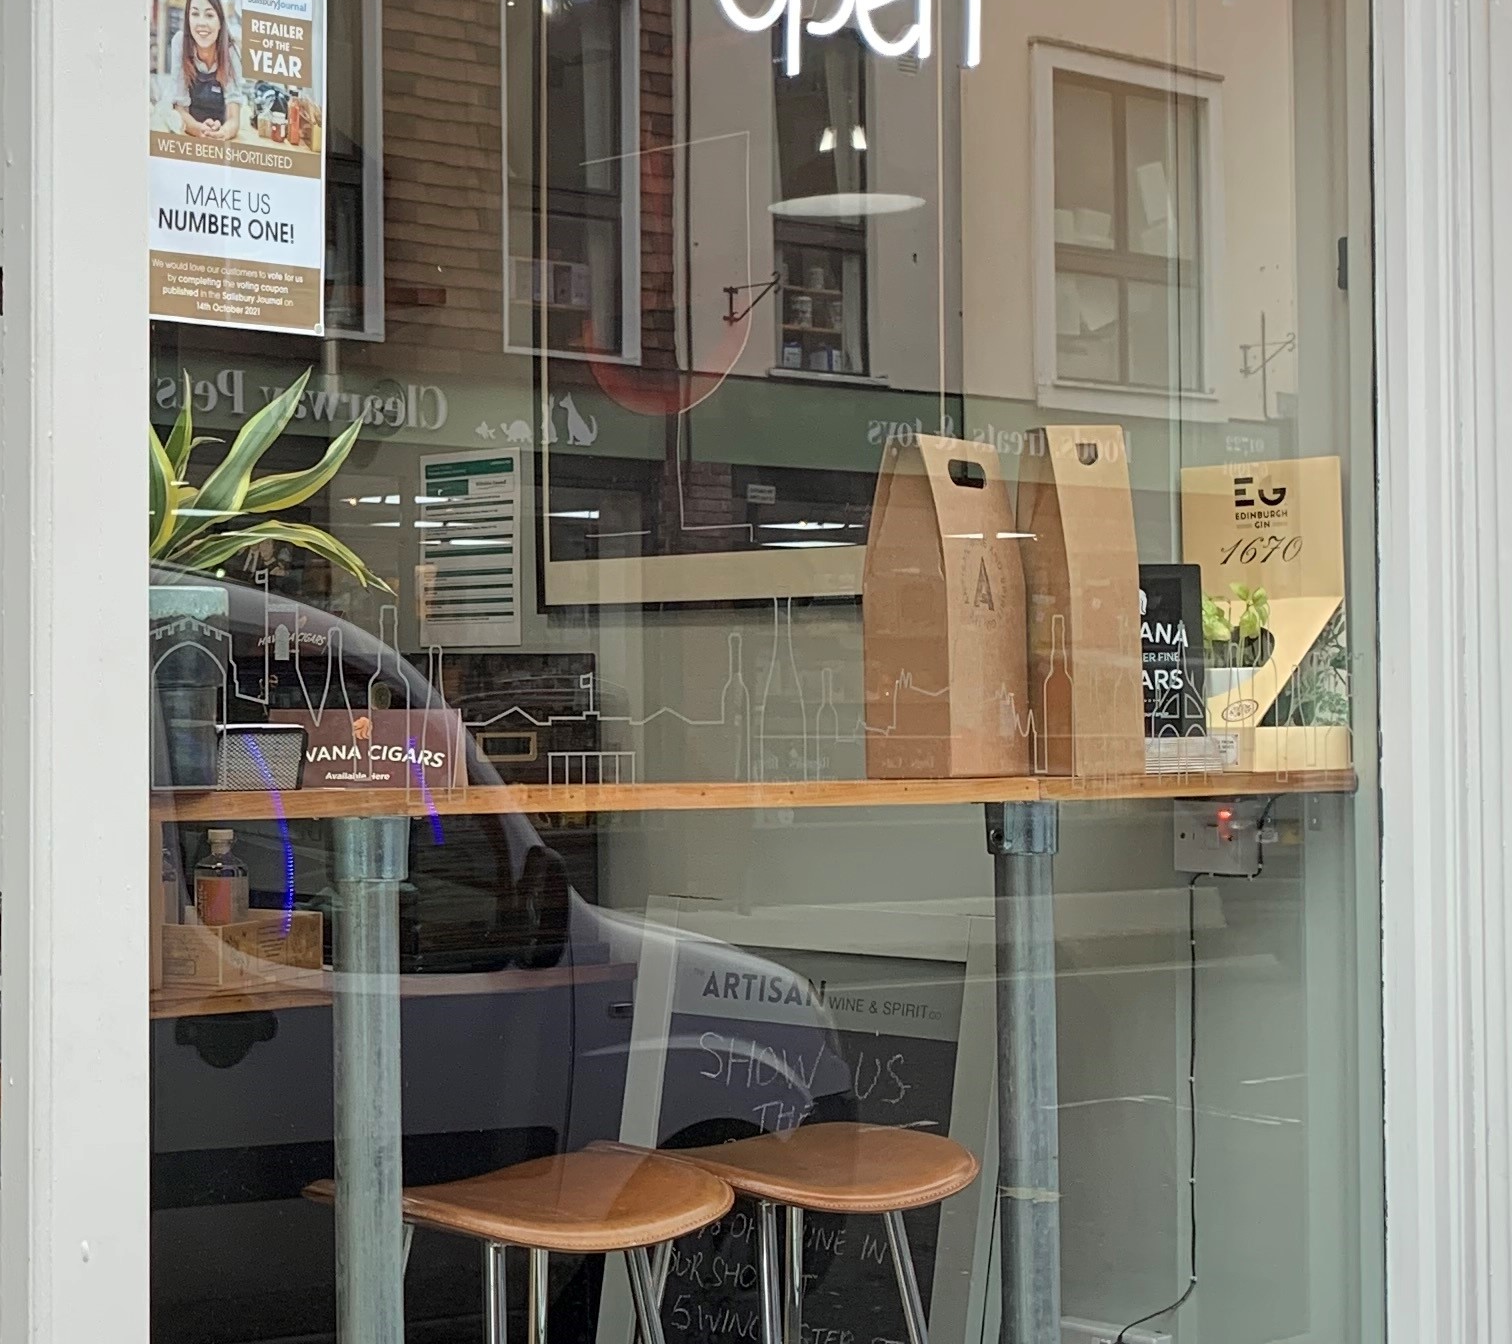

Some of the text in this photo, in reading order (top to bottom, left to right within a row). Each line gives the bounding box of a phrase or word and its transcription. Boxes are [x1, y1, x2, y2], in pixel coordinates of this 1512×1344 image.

[251, 18, 303, 41] RETAILER
[262, 38, 290, 52] OF THE
[249, 49, 302, 79] YEAR
[157, 138, 293, 170] WE'VE BEEN SHORTLISTED
[185, 183, 271, 215] MAKE US
[158, 208, 295, 244] NUMBER ONE!
[152, 259, 303, 283] We would love our customers to vote for us
[162, 286, 199, 298] published
[200, 290, 207, 298] in
[208, 290, 220, 299] the
[222, 291, 255, 305] Salisbury
[256, 294, 283, 305] Journal
[167, 274, 289, 295] by completing the voting coupon
[196, 301, 261, 316] 14th October 2021
[1233, 475, 1287, 507] EG
[1234, 510, 1289, 521] EDINBURGH
[1254, 520, 1271, 529] GIN
[1219, 534, 1304, 566] 1670
[1140, 621, 1189, 648] ANA
[1158, 652, 1181, 663] FINE
[1141, 669, 1184, 691] ARS
[306, 744, 446, 768] VANA CIGARS
[325, 772, 367, 781] Available
[702, 970, 827, 1008] ARTISAN
[828, 996, 865, 1014] WINE
[869, 1003, 878, 1014] &
[883, 1000, 928, 1019] SPIRIT
[699, 1031, 912, 1104] SHOW US
